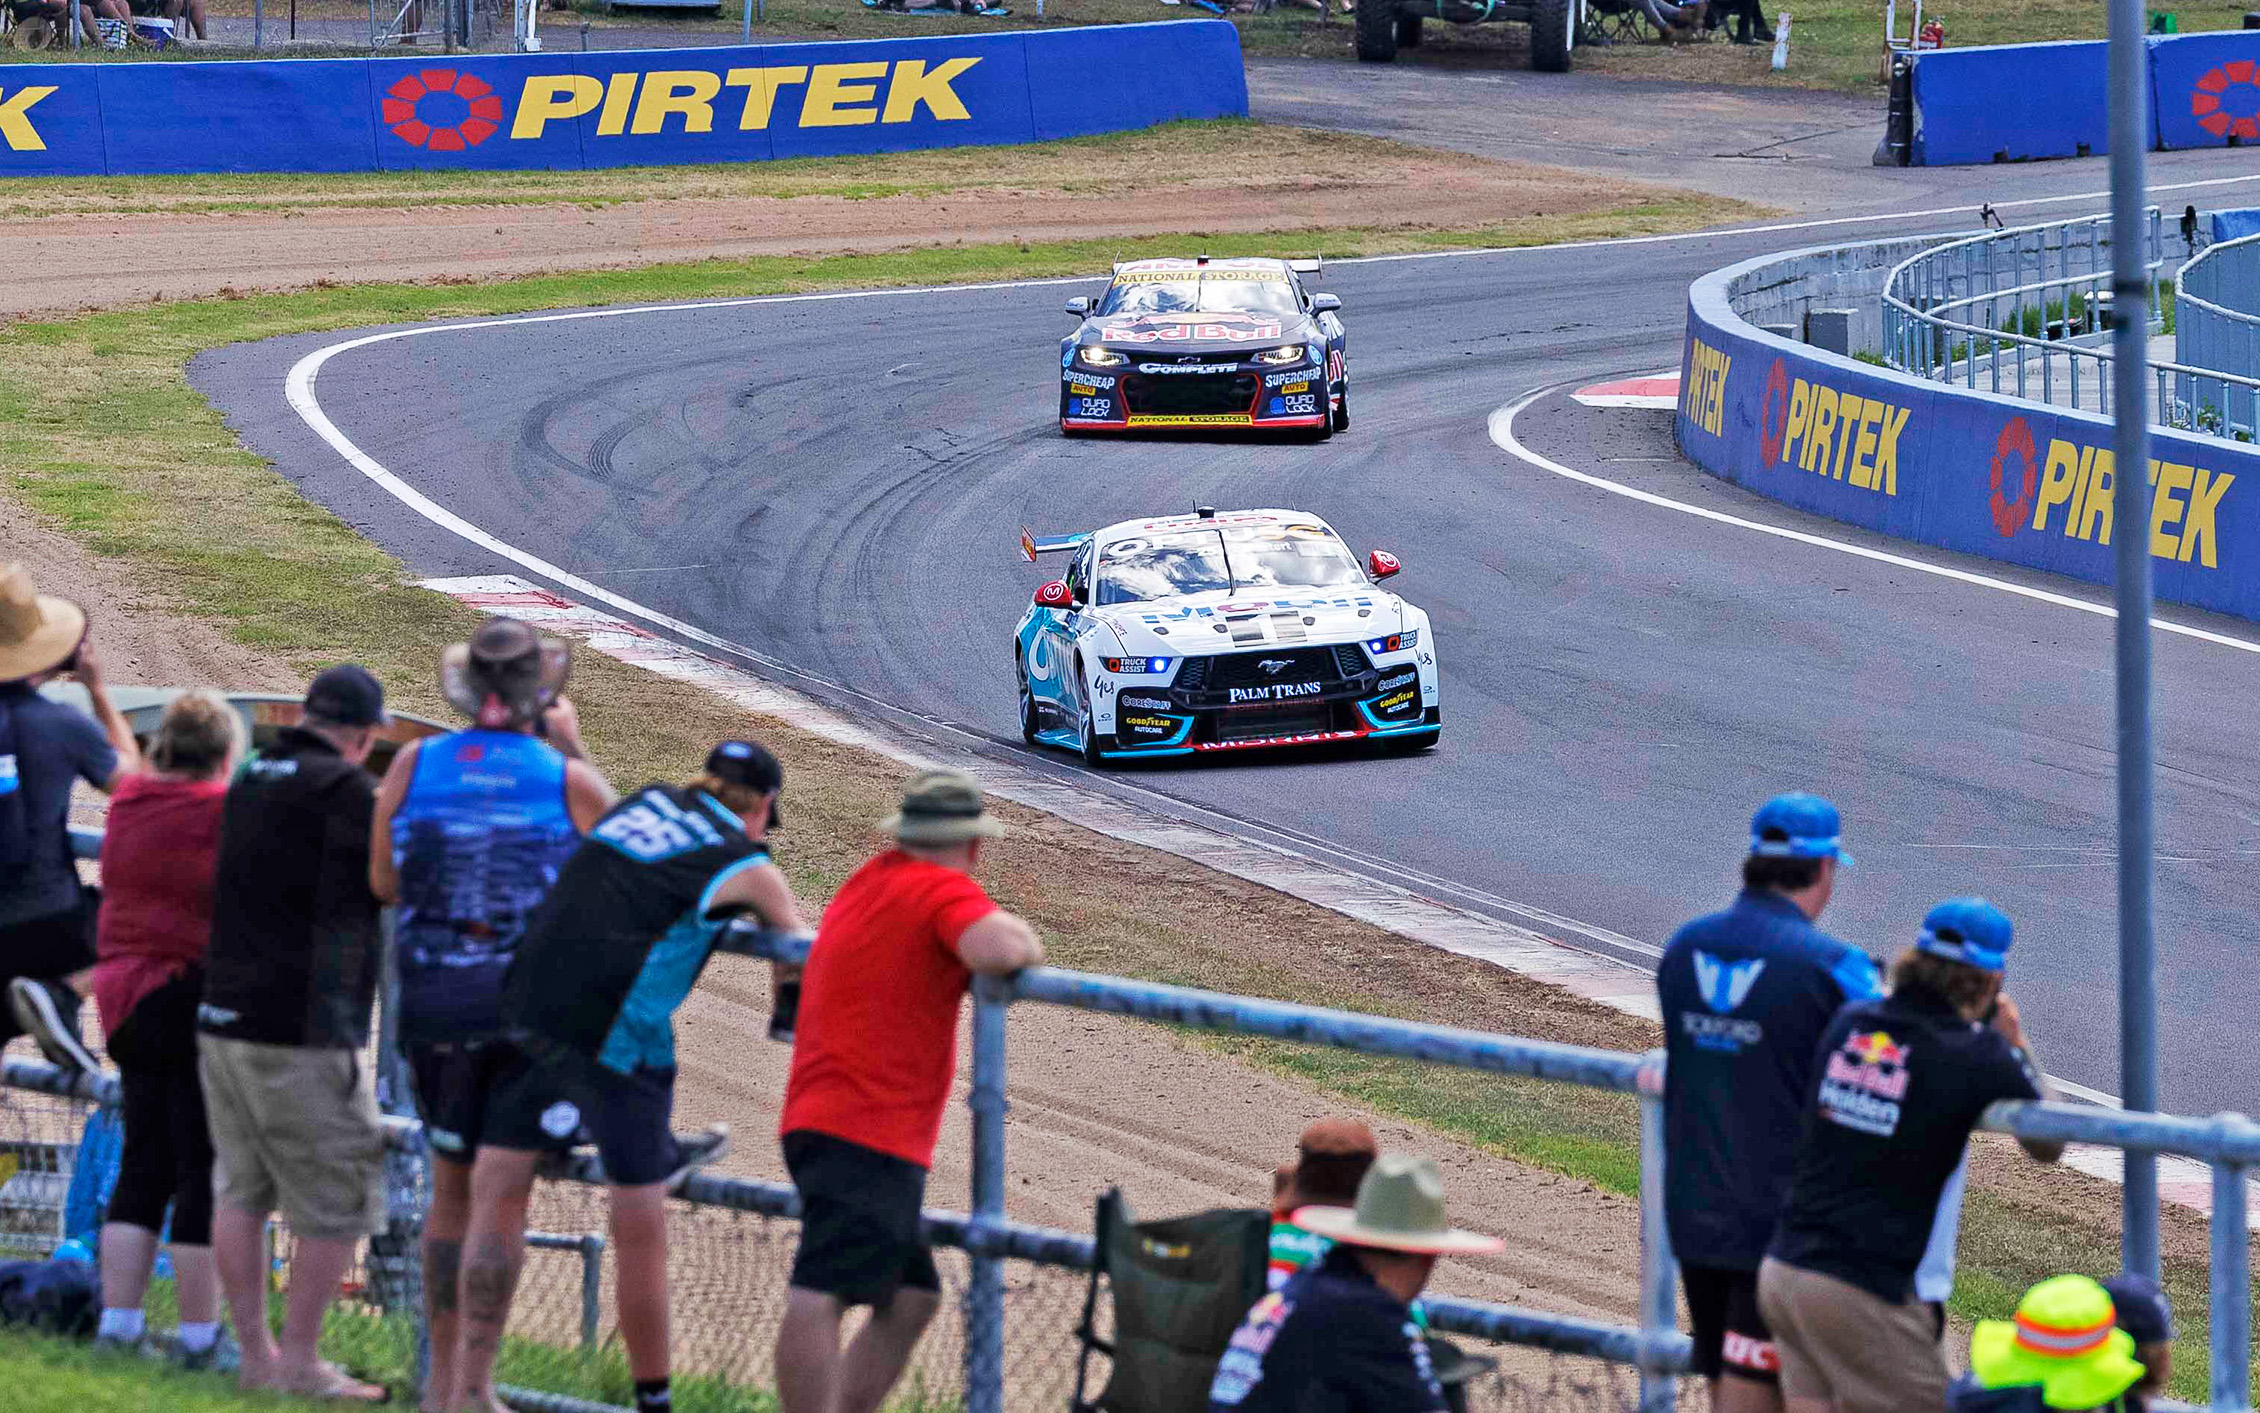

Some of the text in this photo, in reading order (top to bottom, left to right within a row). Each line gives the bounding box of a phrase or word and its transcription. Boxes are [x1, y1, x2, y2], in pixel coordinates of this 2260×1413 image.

[510, 57, 983, 139] PIRTEK
[1118, 272, 1285, 283] NATIONAL STORAGE
[1102, 322, 1282, 341] Red Bull
[1063, 369, 1116, 390] SUPERCHEAP
[1265, 366, 1322, 388] SUPERCHEAP
[1072, 384, 1095, 394] AUTO
[1283, 383, 1306, 392] AUTO
[1082, 397, 1111, 409] QUAD
[1285, 394, 1315, 405] QUAD
[1080, 407, 1110, 417] LOCK
[1285, 403, 1316, 413] LOCK
[1781, 377, 1912, 496] PIRTEK
[1120, 658, 1147, 666] TRUCK
[1119, 665, 1146, 673] ASSIST
[1229, 681, 1322, 703] PALM TRANS
[1380, 691, 1414, 708] GOODYEAR
[1126, 717, 1171, 727] GOODYEAR
[1134, 725, 1164, 734] AUTOCARE
[597, 804, 692, 858] 25
